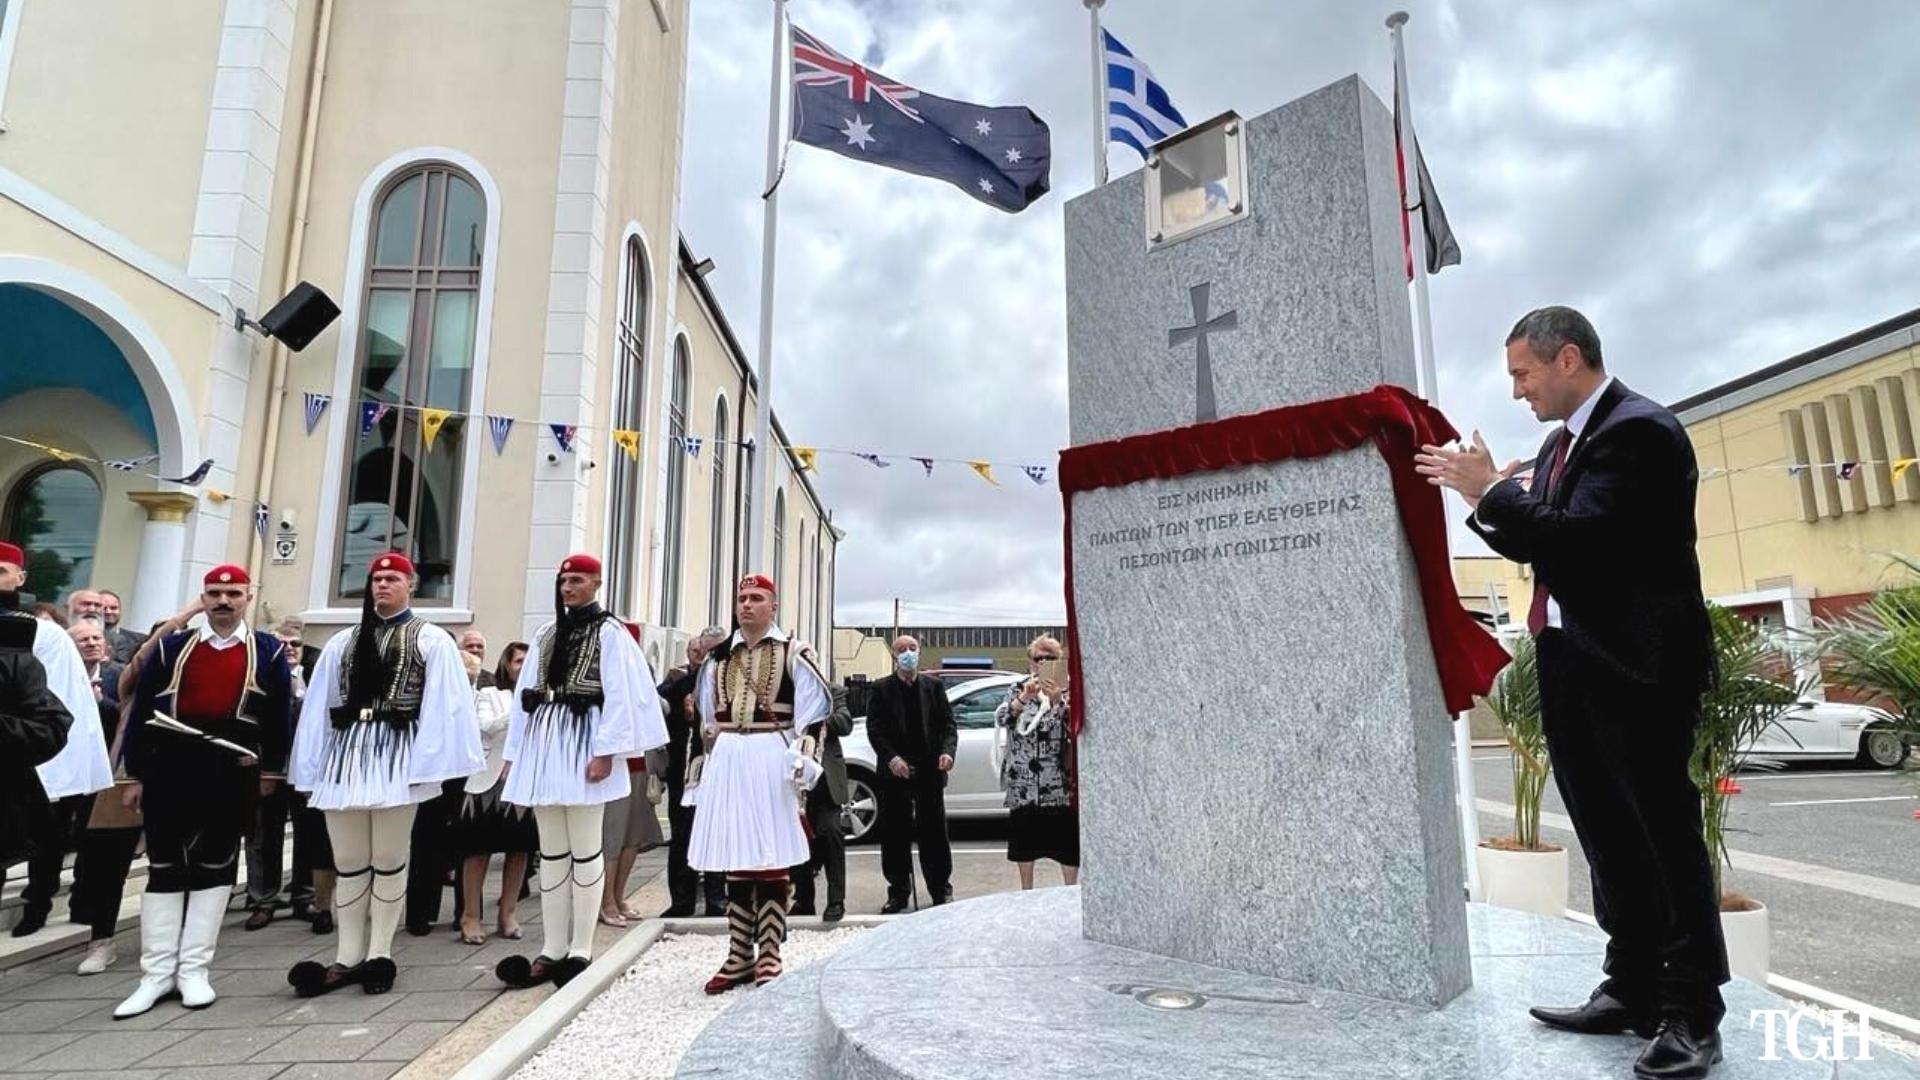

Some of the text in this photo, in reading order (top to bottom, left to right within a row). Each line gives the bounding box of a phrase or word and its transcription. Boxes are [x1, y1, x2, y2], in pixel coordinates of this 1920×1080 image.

[1158, 480, 1268, 510] ΕΙΣ ΜΝΗΜΗΝ
[1089, 494, 1362, 547] ΠΑΝΤΩΝ ΤΩΝ ΥΠΕΡ ΕΛΕΥΘΕΡΙΑΣ
[1119, 532, 1322, 570] ΠΕΣΟΝΤΩΝ ΑΓΩΝΙΣΤΩΝ
